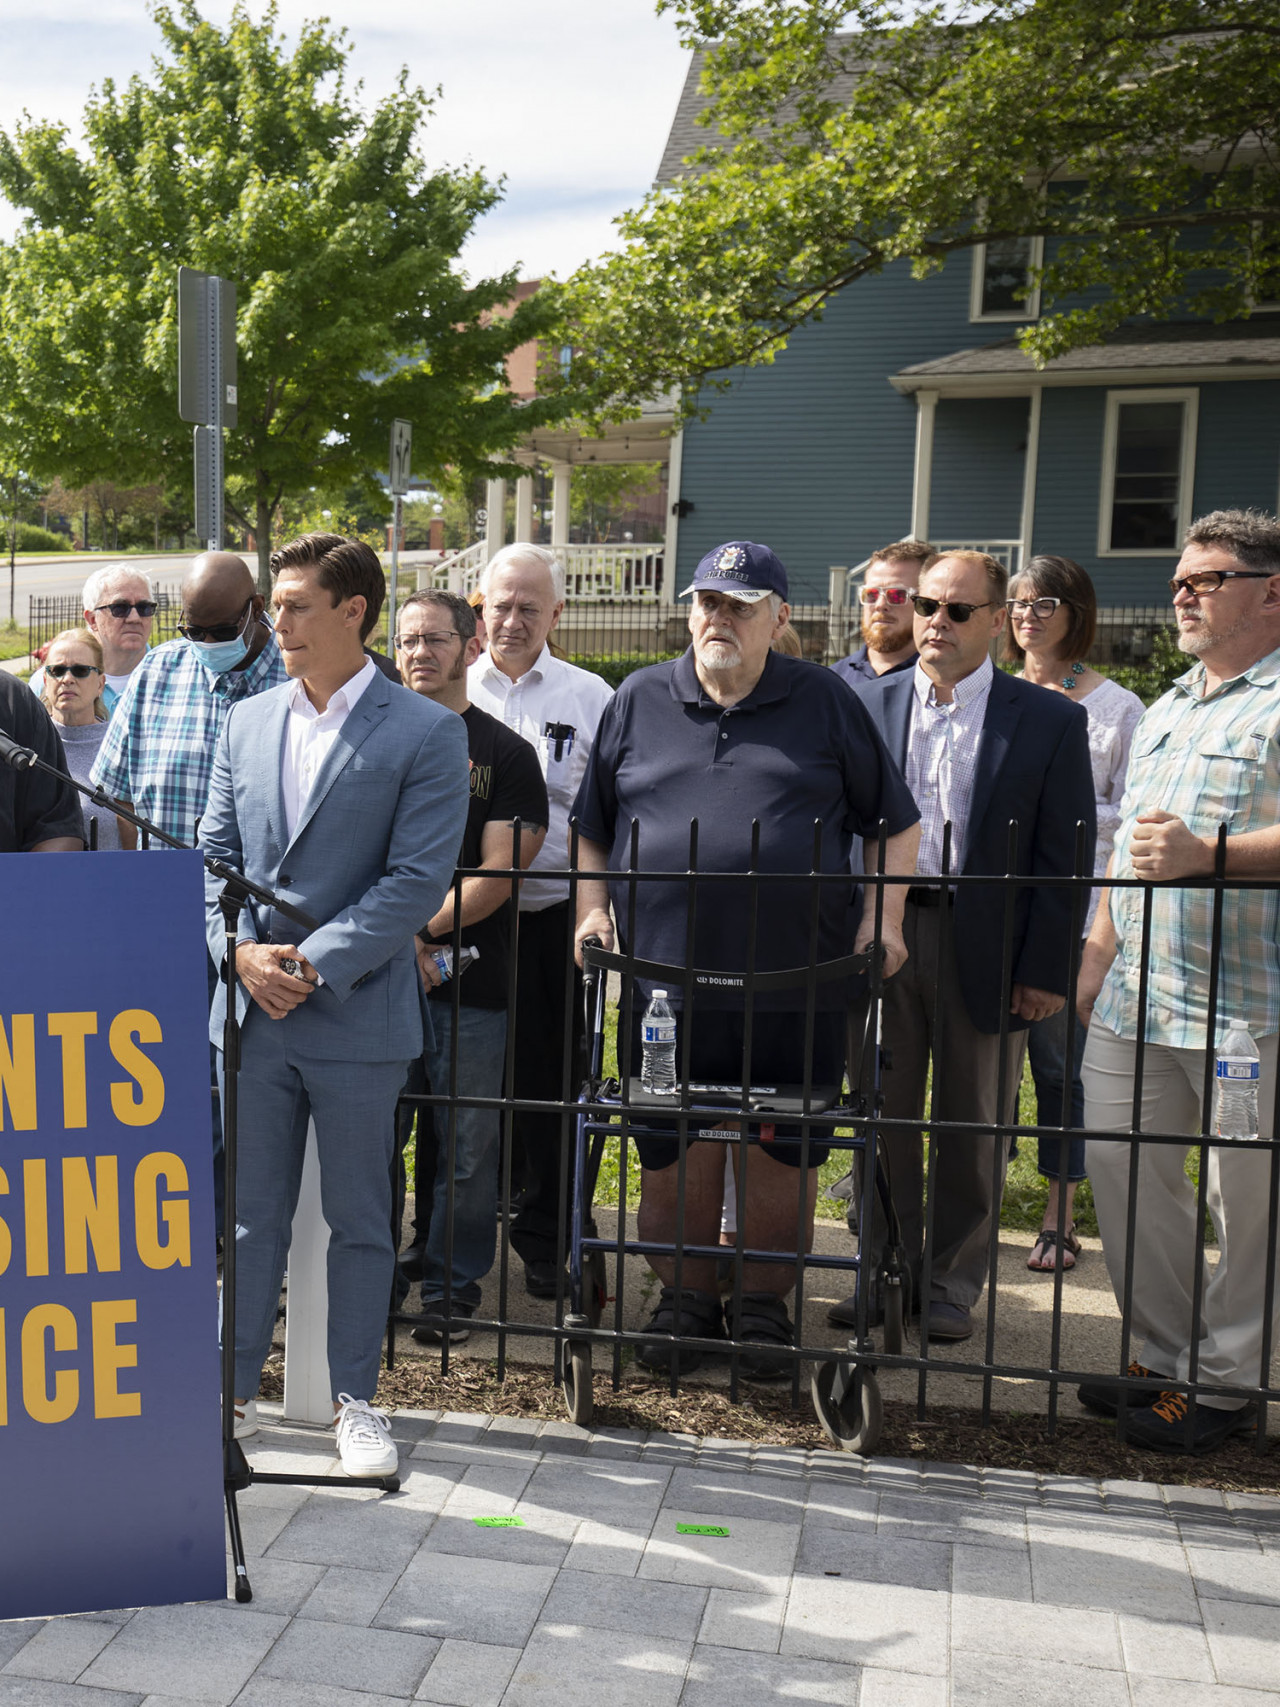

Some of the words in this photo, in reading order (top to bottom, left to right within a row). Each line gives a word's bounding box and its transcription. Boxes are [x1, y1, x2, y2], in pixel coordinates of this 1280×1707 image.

[469, 765, 491, 799] ON
[709, 976, 744, 987] DOLOMITE
[712, 1131, 740, 1139] DOLOMI
